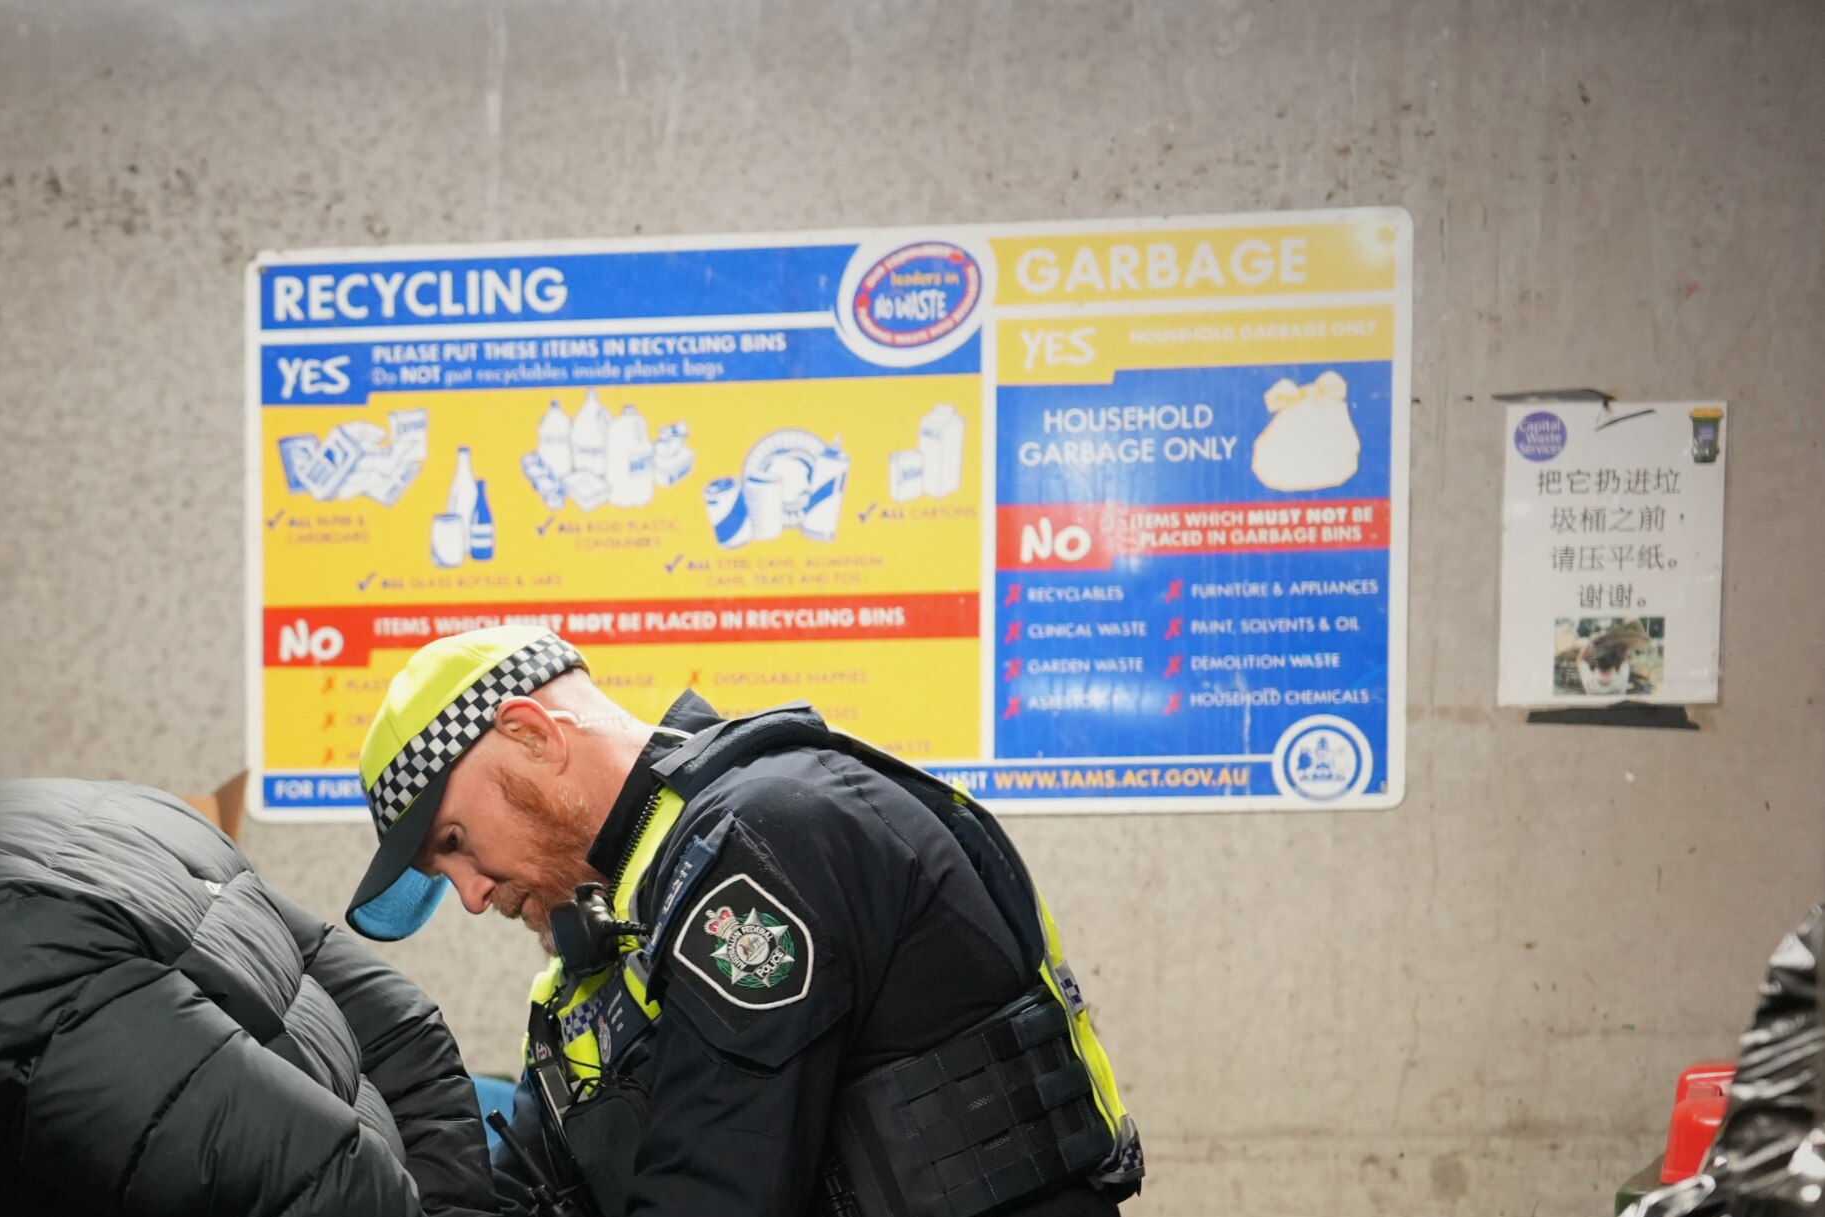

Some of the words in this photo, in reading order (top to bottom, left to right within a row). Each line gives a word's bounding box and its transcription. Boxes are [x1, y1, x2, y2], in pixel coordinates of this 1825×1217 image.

[1017, 237, 1307, 294] GARBAGE
[891, 271, 942, 287] leaders
[274, 267, 568, 321] RECYCLING
[1239, 323, 1327, 342] GARBAGE
[1331, 320, 1376, 338] ONLY
[374, 343, 439, 363] PLEASE
[443, 341, 477, 362] PUT
[484, 340, 538, 360] THESE
[543, 338, 598, 358] ITEMS
[604, 337, 626, 357] IN
[630, 333, 736, 356] RECYCLING
[740, 331, 786, 352] BINS
[1021, 326, 1096, 370] YES
[277, 355, 350, 399] YES
[400, 365, 440, 384] NOT
[444, 366, 472, 387] put
[476, 361, 568, 385] recyclables
[573, 358, 621, 378] inside
[624, 357, 678, 380] plastic
[682, 355, 724, 378] bags
[1044, 405, 1214, 433] HOUSEHOLD
[1519, 420, 1561, 434] Capital
[1526, 432, 1562, 444] Waste
[1019, 438, 1155, 466] GARBAGE
[1163, 436, 1237, 463] ONLY
[1537, 468, 1681, 496] 把它扔进垃
[1131, 511, 1180, 530] ITEMS
[1183, 509, 1244, 528] WHICH
[1247, 508, 1301, 526] MUST
[1306, 506, 1349, 525] NOT
[1352, 506, 1374, 523] BE
[1140, 529, 1204, 547] PLACED
[1207, 528, 1227, 545] IN
[1231, 527, 1316, 545] GARBAGE
[1321, 525, 1362, 542] BINS
[1550, 545, 1678, 572] 请压平纸。
[1027, 586, 1124, 603] RECYCLABLES
[1190, 582, 1268, 599] FURNITURE
[1271, 581, 1284, 597] &
[1288, 578, 1379, 596] APPLIANCES
[1578, 583, 1647, 610] 谢谢。
[375, 616, 431, 637] ITEMS
[568, 613, 614, 633] NOT
[618, 614, 641, 631] BE
[645, 611, 717, 631] PLACED
[720, 610, 743, 628] IN
[746, 609, 854, 629] RECYCLING
[858, 606, 906, 627] BINS
[1027, 622, 1092, 640] CLINICAL
[1096, 620, 1148, 638] WASTE
[1240, 617, 1315, 634] SOLVENTS
[1318, 616, 1330, 632] &
[1334, 616, 1361, 632] OIL
[1027, 658, 1095, 675] GARDEN
[1098, 656, 1144, 673] WASTE
[1190, 654, 1286, 672] DEMOLITION
[1289, 652, 1341, 669] WASTE
[594, 675, 655, 688] ARBAGE
[1189, 690, 1280, 707] HOUSEHOLD
[1284, 688, 1371, 706] CHEMICALS
[275, 778, 314, 799] FOR
[994, 768, 1249, 791] WWW.TAMS.ACT.GOV.AU
[740, 925, 774, 942] FEDERAL
[755, 948, 785, 978] POLICE
